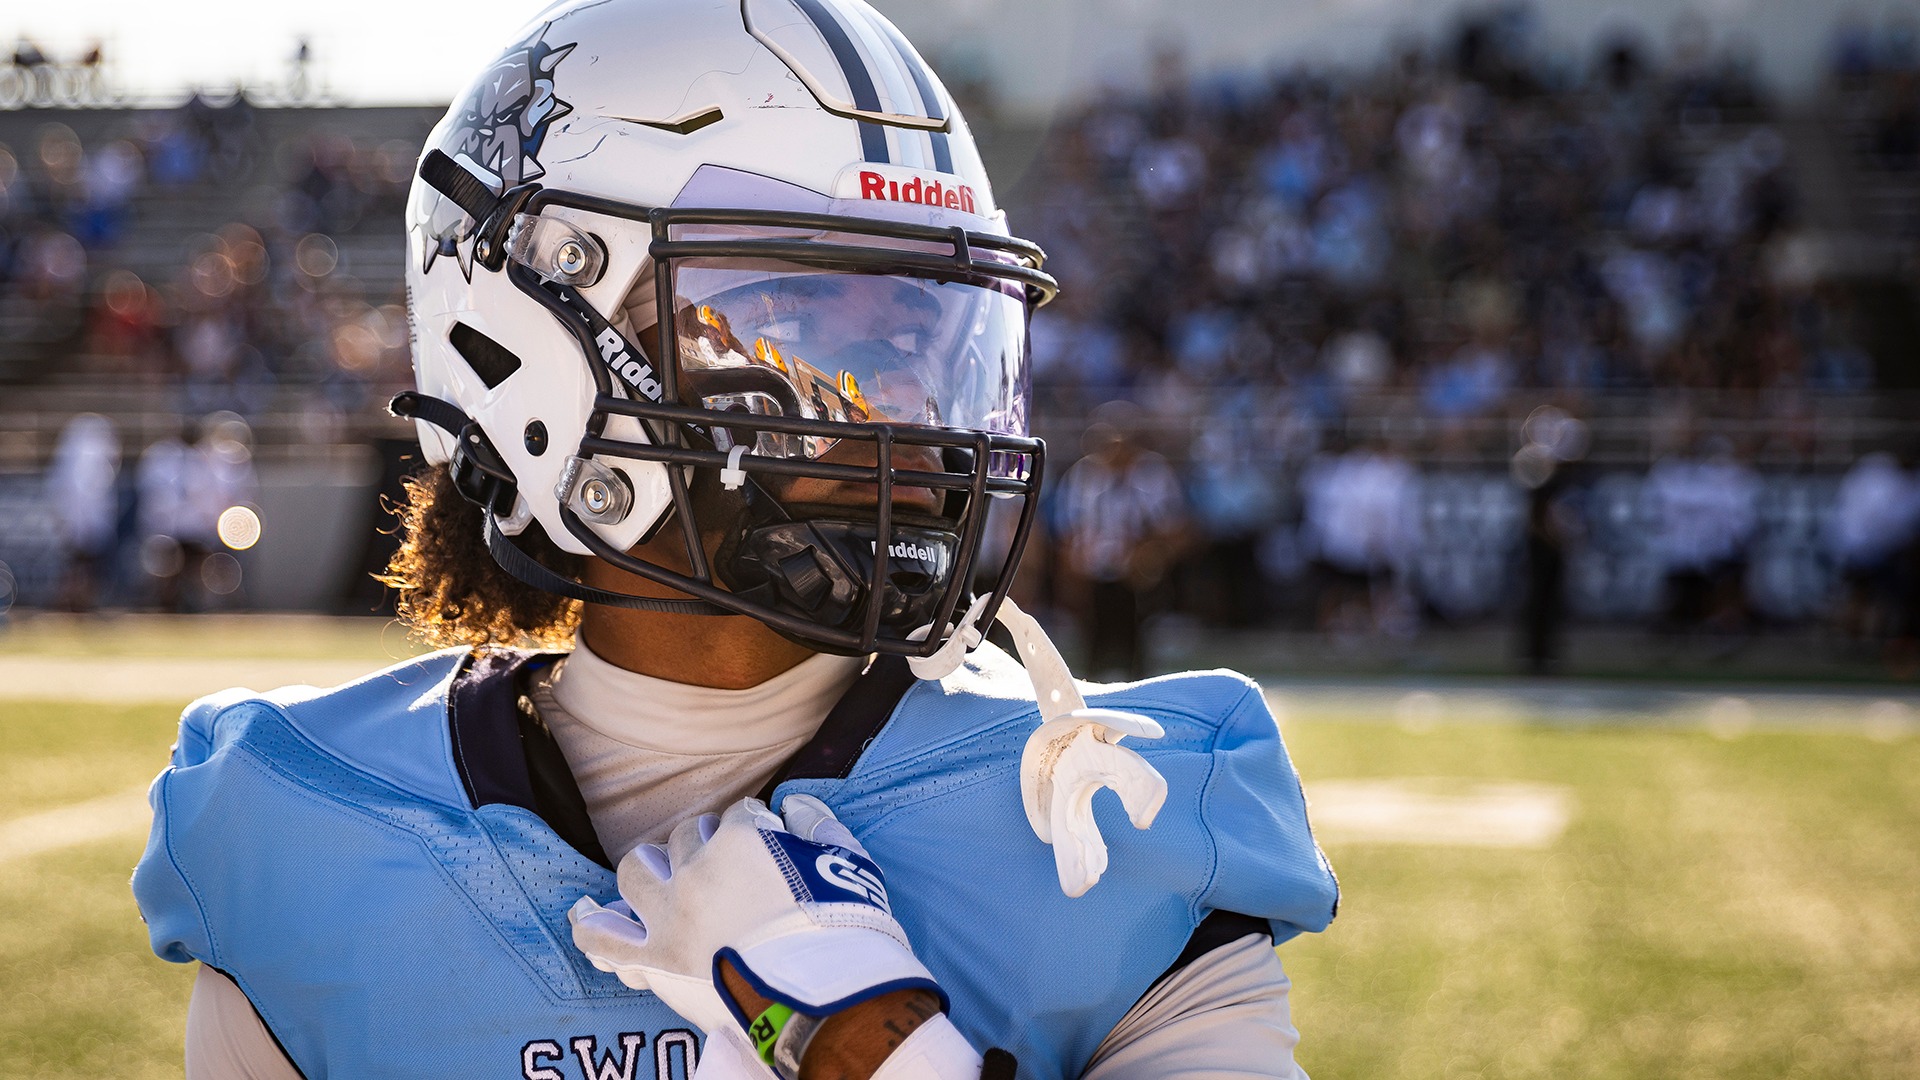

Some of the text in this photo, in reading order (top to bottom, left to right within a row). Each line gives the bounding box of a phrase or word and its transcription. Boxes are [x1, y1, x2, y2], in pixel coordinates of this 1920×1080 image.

[859, 171, 975, 214] Riddell
[596, 326, 662, 404] Ridd
[871, 541, 936, 563] iddell
